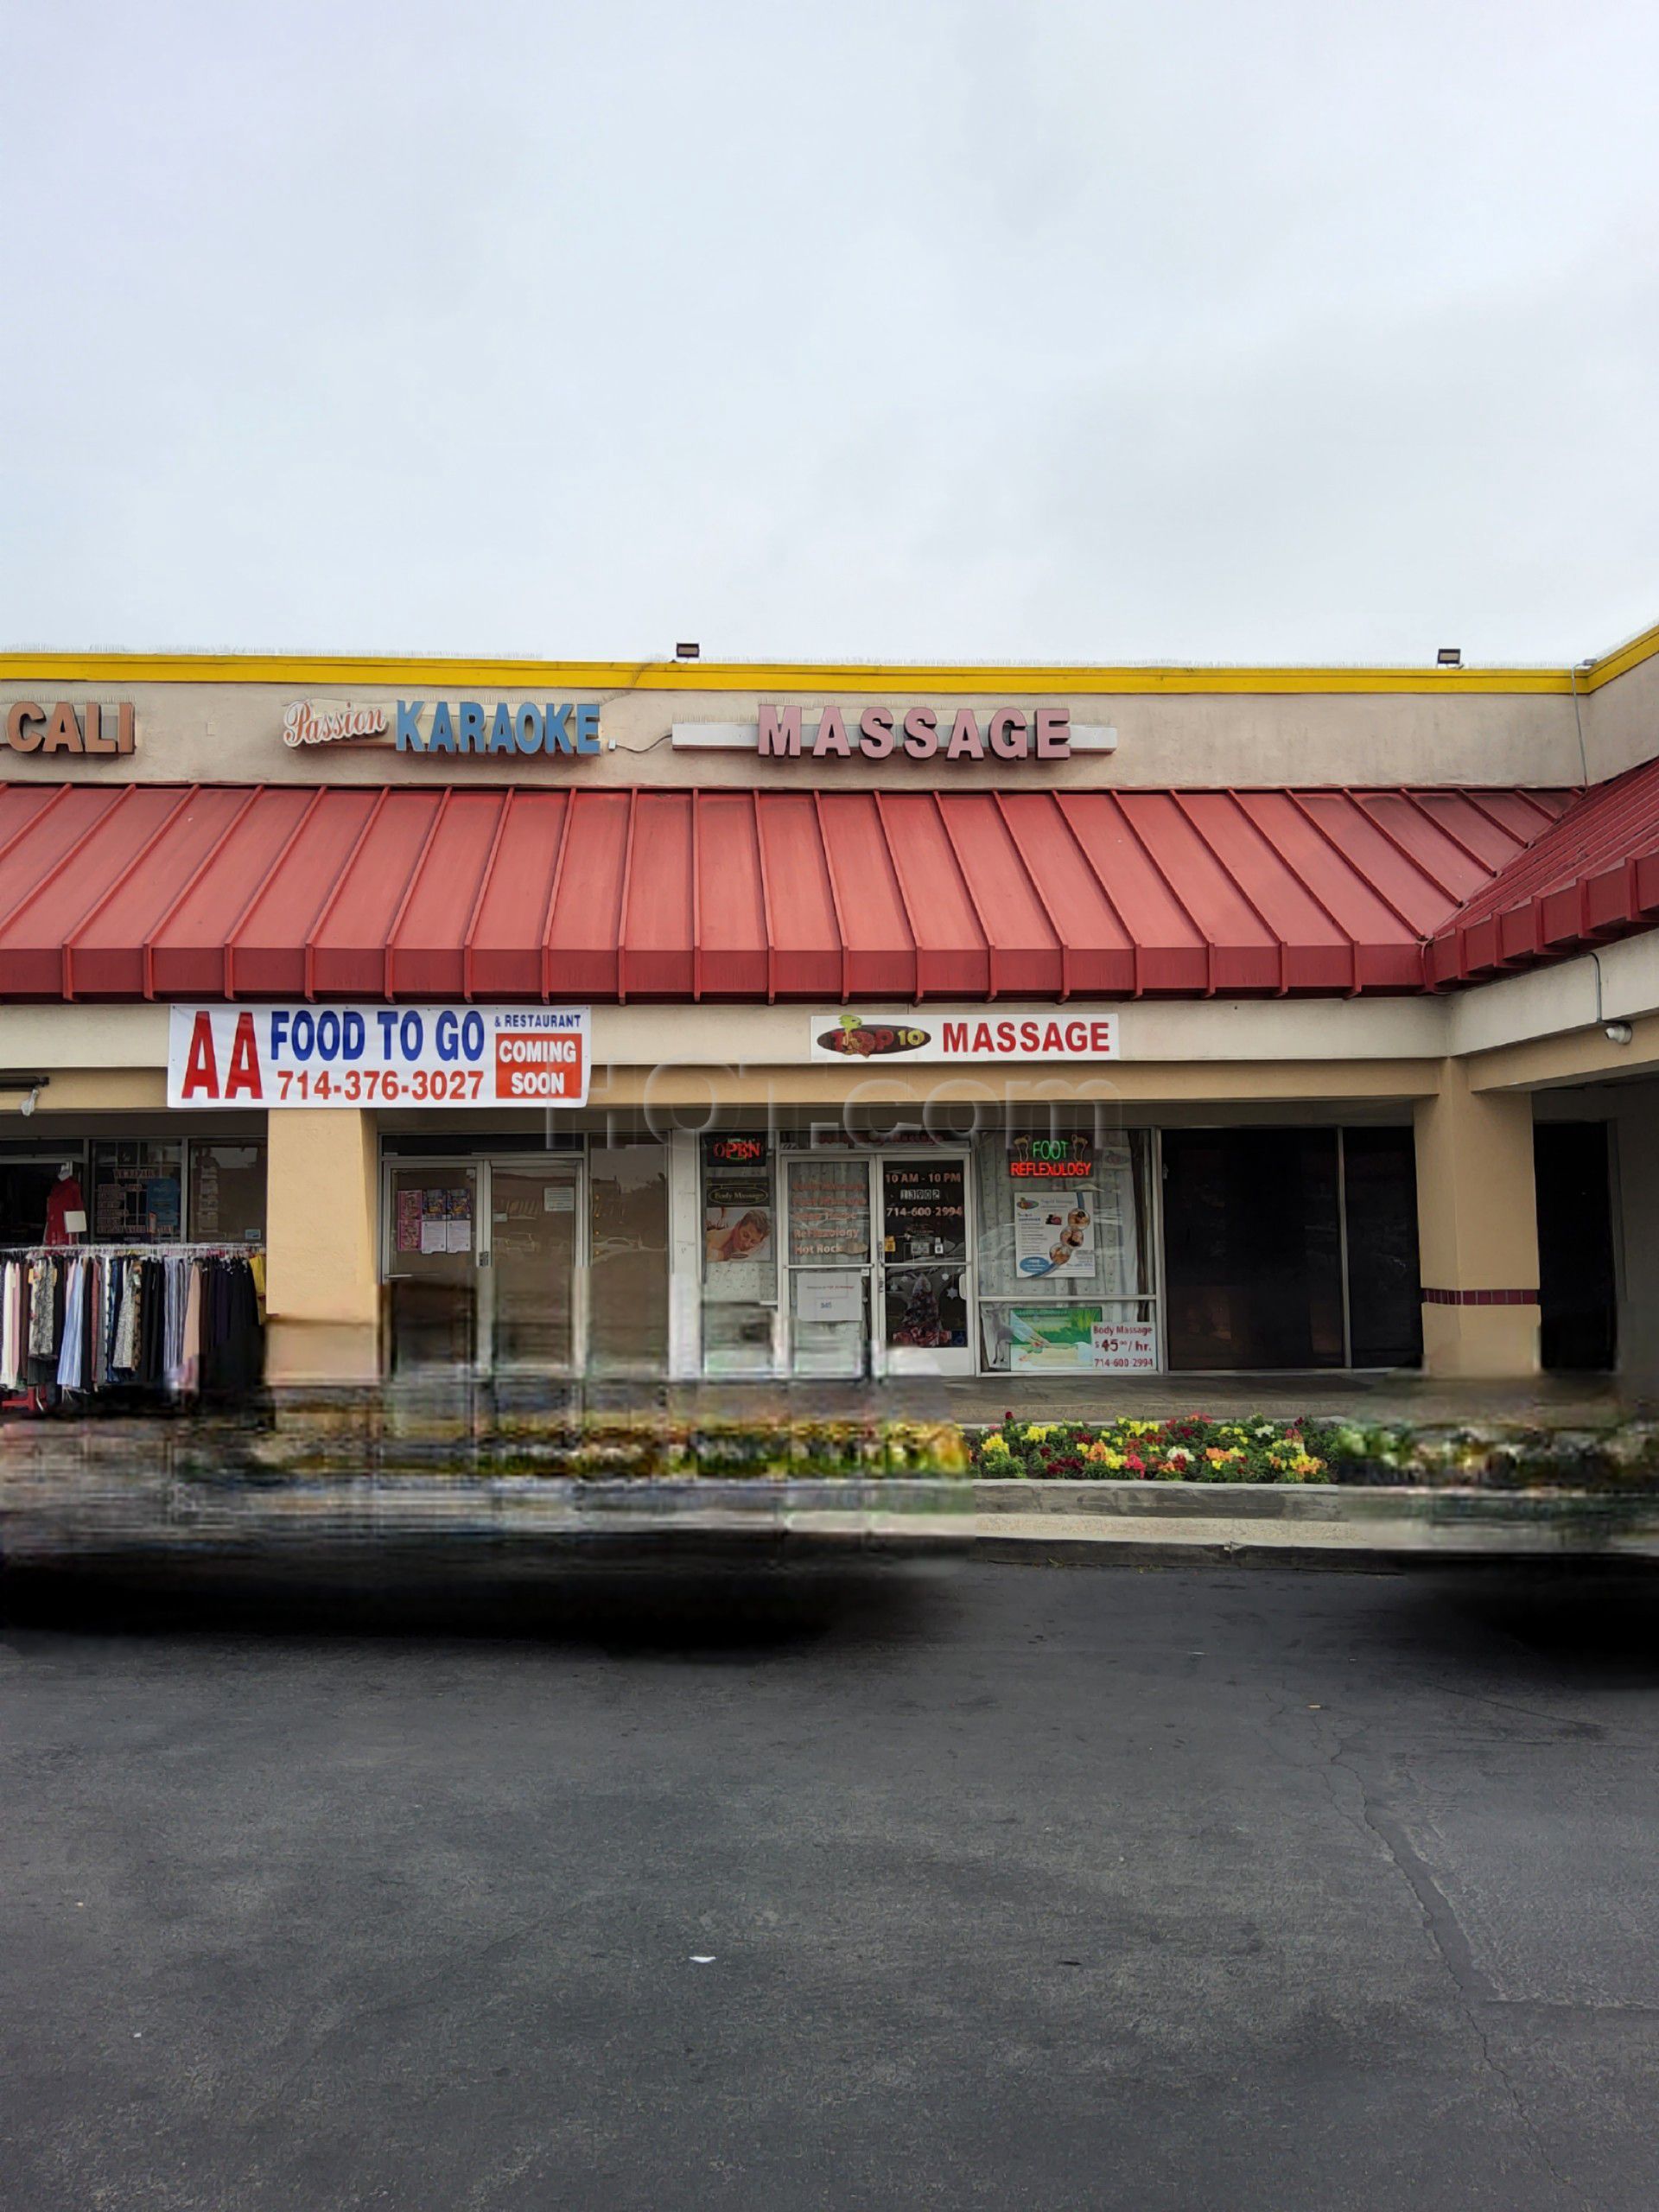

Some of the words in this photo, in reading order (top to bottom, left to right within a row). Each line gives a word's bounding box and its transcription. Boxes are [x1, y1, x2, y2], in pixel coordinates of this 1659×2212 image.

[7, 701, 134, 753] CALI
[283, 699, 386, 747] Passion
[396, 700, 601, 754] KARAOKE
[758, 704, 1071, 760] MASSAGE
[494, 1016, 501, 1028] &
[505, 1014, 581, 1028] RESTAURANT
[270, 1010, 365, 1061] FOOD
[377, 1010, 423, 1061] TO
[435, 1010, 485, 1061] GO
[898, 1029, 925, 1046] 10
[943, 1022, 1110, 1052] MASSAGE
[181, 1011, 263, 1099] AA
[499, 1039, 576, 1063] COMING
[277, 1070, 484, 1101] 714-376-3027
[511, 1071, 565, 1095] SOON
[1033, 1140, 1070, 1160] FOOT
[885, 1173, 899, 1183] 10
[901, 1173, 919, 1183] AM
[929, 1173, 941, 1183] 10
[944, 1173, 961, 1182] PM
[1093, 1325, 1113, 1337] Body
[1116, 1325, 1153, 1337] Massage
